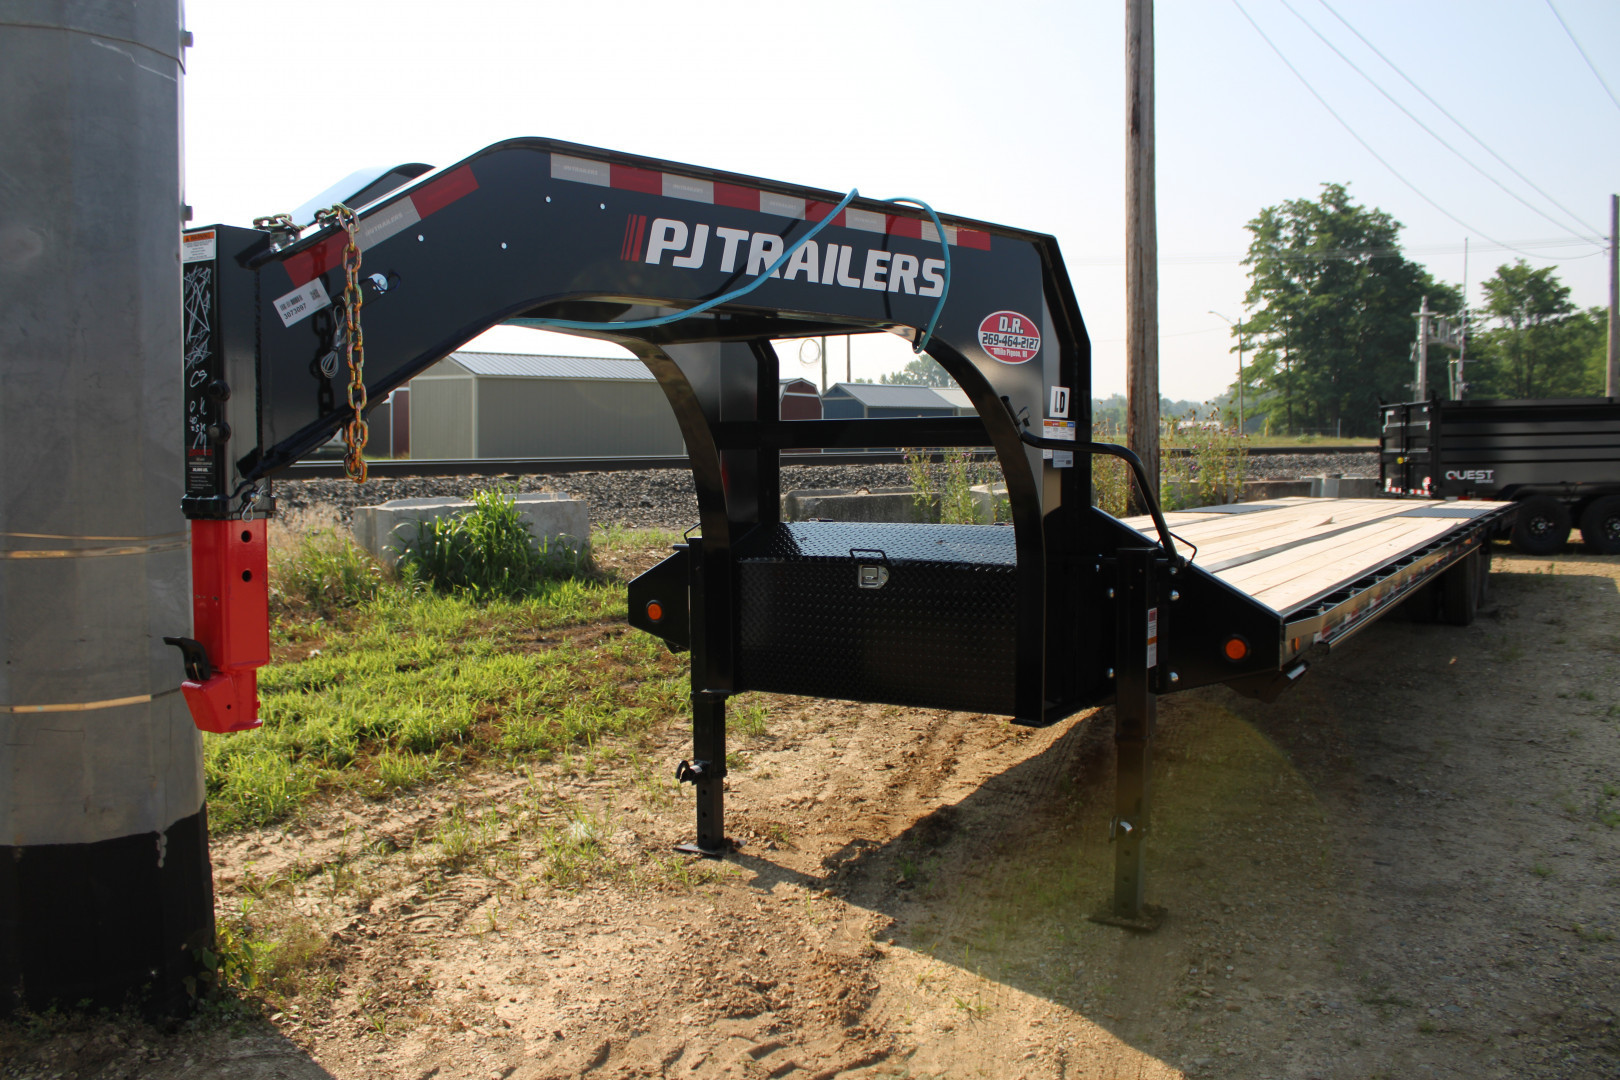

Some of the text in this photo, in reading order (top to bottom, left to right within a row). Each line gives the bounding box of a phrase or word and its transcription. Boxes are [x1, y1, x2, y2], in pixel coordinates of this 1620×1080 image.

[645, 217, 946, 298] PJ TRAILERS
[998, 315, 1024, 334] D.R.
[982, 332, 1039, 350] 269-464-2127
[1445, 470, 1494, 480] QUEST
